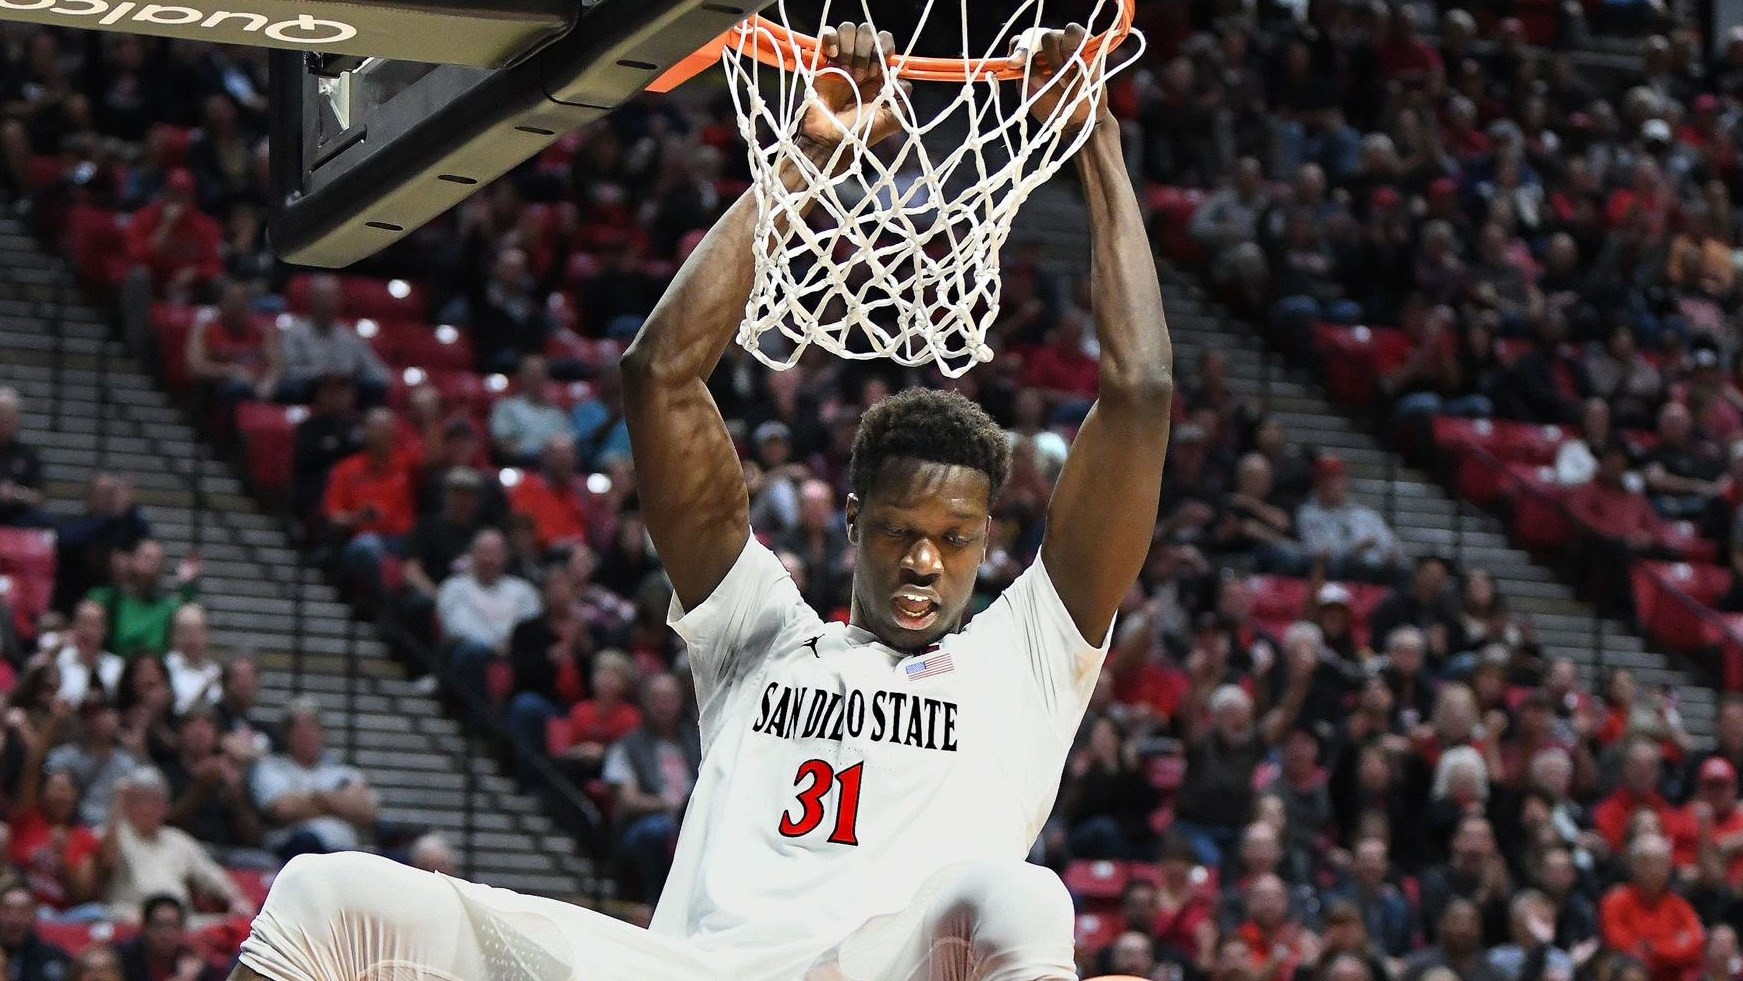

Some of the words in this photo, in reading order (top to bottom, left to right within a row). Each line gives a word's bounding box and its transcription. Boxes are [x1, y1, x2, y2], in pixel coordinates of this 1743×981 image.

[752, 681, 809, 740] SAN
[801, 689, 865, 742] DIO
[870, 690, 958, 752] STATE
[778, 758, 864, 846] 31
